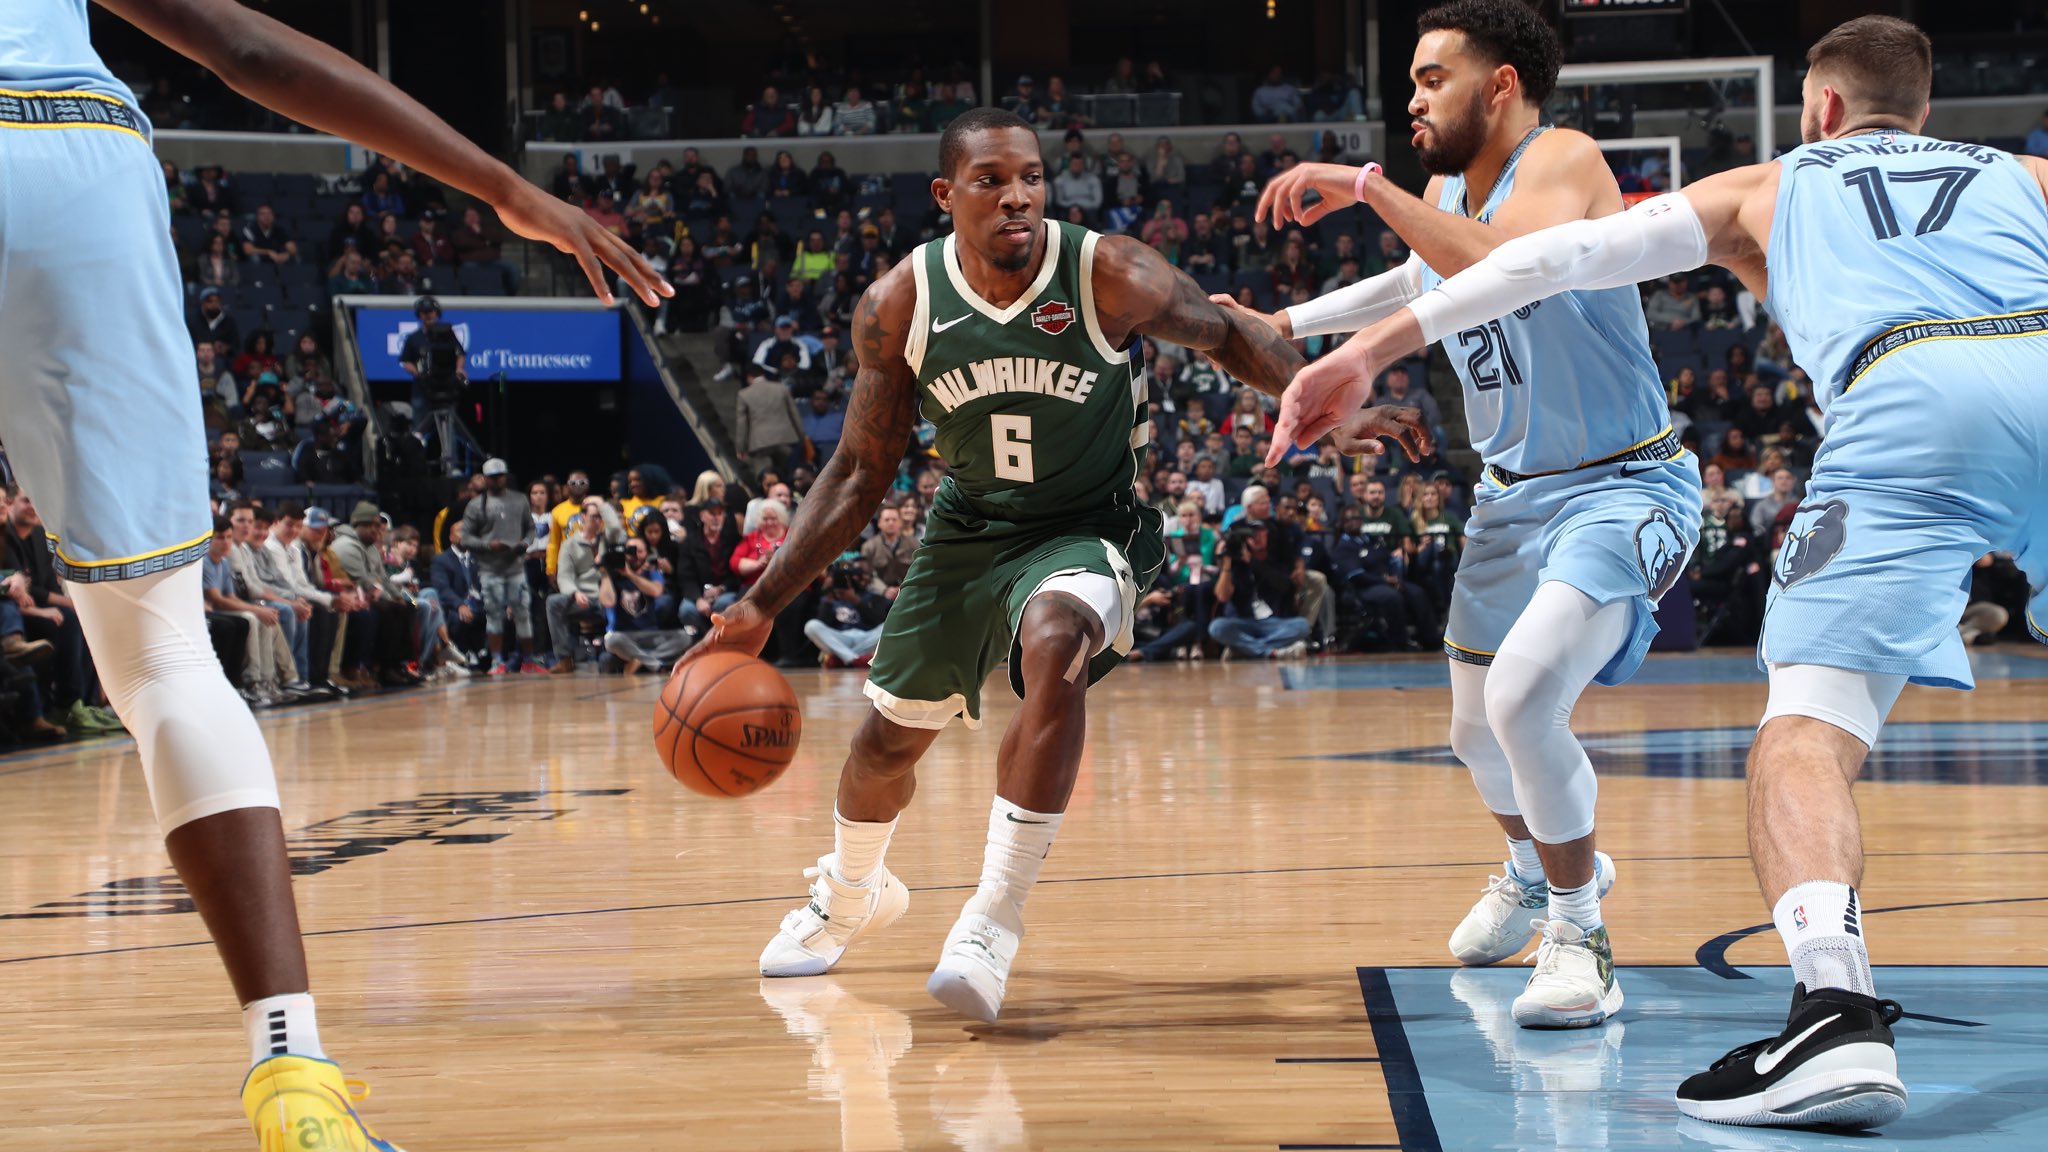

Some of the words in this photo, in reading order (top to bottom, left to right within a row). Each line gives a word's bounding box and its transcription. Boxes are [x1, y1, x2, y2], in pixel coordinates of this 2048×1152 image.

[1843, 166, 1981, 240] 17
[470, 349, 492, 368] of
[495, 349, 592, 369] Tennessee
[927, 357, 1098, 413] MILWAUKEE
[1458, 319, 1523, 391] 21
[990, 414, 1034, 483] 6
